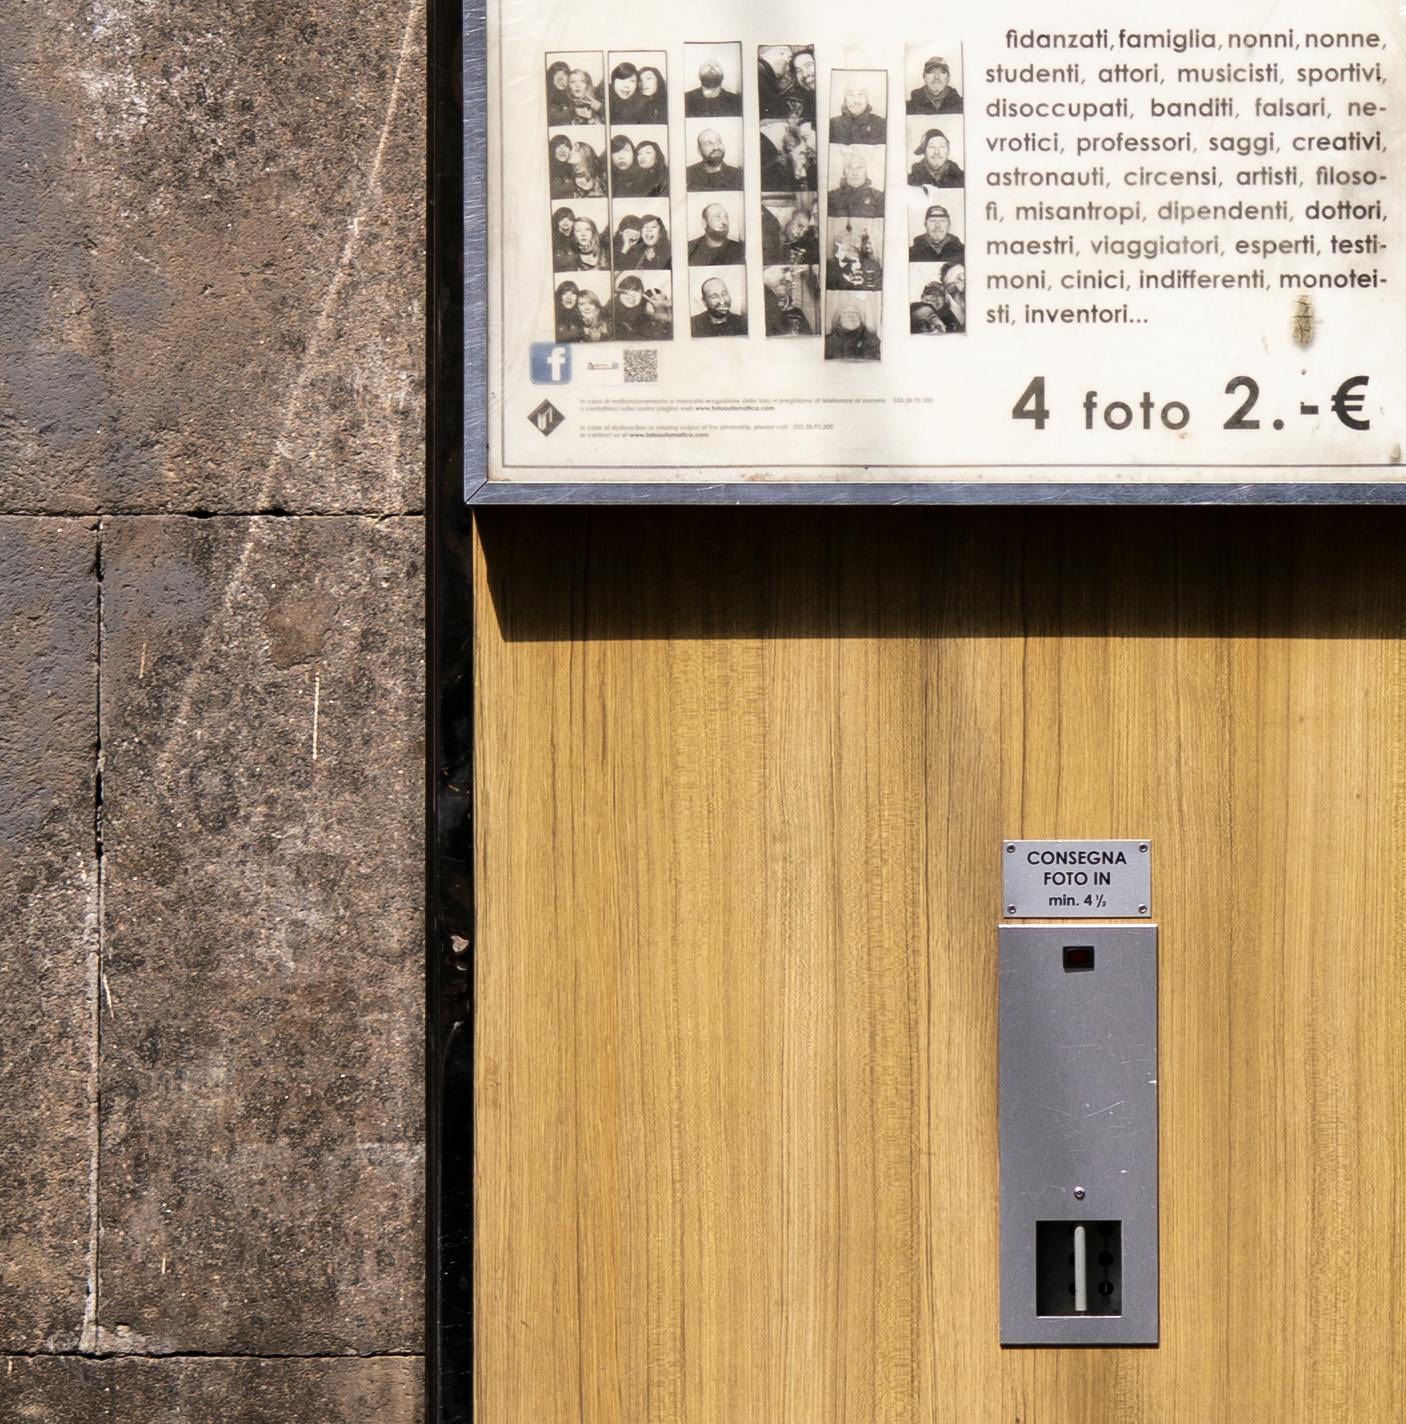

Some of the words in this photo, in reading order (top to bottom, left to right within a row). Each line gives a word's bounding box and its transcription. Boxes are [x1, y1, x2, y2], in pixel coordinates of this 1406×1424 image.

[1006, 29, 1114, 50] fidanzati,
[1119, 29, 1222, 53] famiglia,
[1229, 29, 1299, 50] nonni,
[1306, 33, 1386, 50] nonne,
[986, 64, 1085, 84] studenti,
[1099, 63, 1164, 85] attori,
[1178, 63, 1283, 84] musicisti,
[1298, 63, 1387, 87] sportivi,
[986, 98, 1134, 121] disoccupati,
[1151, 98, 1239, 118] banditi,
[1255, 97, 1331, 119] falsari,
[1348, 102, 1386, 116] ne-
[986, 132, 1064, 153] vrotici,
[1077, 132, 1197, 156] professori,
[1209, 132, 1280, 156] saggi,
[1293, 130, 1387, 153] creativi,
[987, 167, 1110, 188] astronauti,
[1124, 166, 1222, 187] circensi,
[1237, 166, 1303, 187] artisti,
[1316, 166, 1387, 185] filoso-
[986, 201, 1003, 222] fi,
[1016, 201, 1146, 225] misantropi,
[1158, 201, 1293, 224] dipendenti,
[1305, 200, 1387, 222] dottori,
[987, 236, 1079, 256] maestri,
[1091, 235, 1224, 259] viaggiatori,
[1236, 235, 1320, 259] esperti,
[1331, 234, 1387, 254] testi-
[987, 270, 1051, 291] moni,
[1061, 270, 1130, 291] cinici,
[1140, 269, 1270, 290] indifferenti,
[1280, 269, 1387, 288] monotei-
[987, 304, 1015, 325] sti,
[1025, 304, 1147, 323] inventori...
[1012, 377, 1049, 429] 4
[1083, 391, 1189, 430] foto
[1027, 851, 1127, 865] CONSEGNA
[1044, 872, 1088, 885] FOTO
[1094, 872, 1110, 885] IN
[1049, 894, 1079, 906] min.
